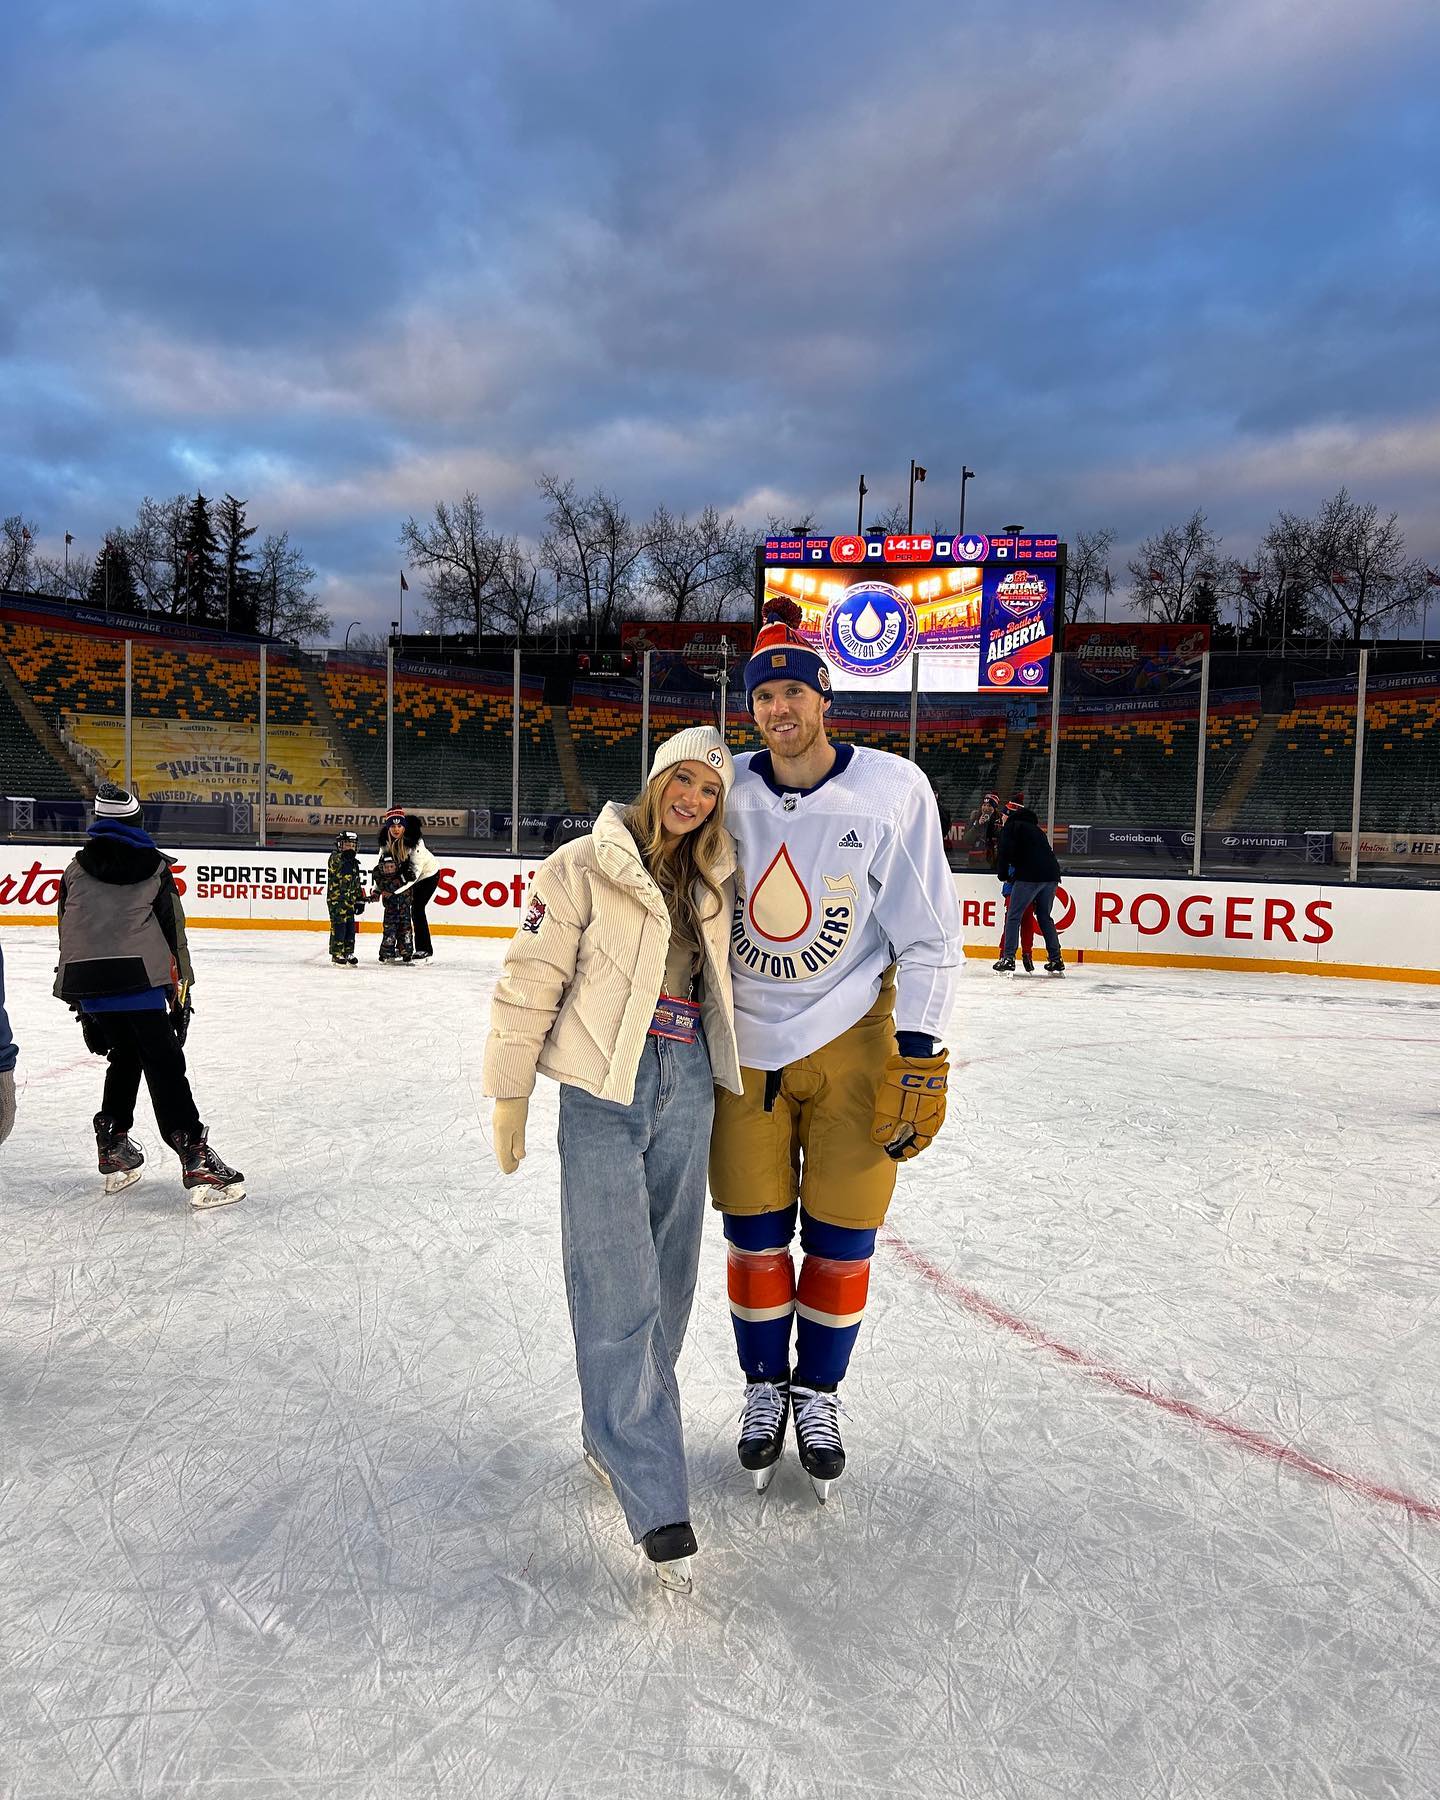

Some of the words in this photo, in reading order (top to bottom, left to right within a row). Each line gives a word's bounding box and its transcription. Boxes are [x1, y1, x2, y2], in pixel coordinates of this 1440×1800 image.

[888, 539, 931, 551] 14:16
[936, 542, 950, 556] 0
[991, 539, 1014, 547] SOG
[812, 550, 822, 560] 0
[868, 543, 882, 557] 0
[997, 547, 1008, 558] 0
[997, 582, 1046, 592] HERITAGE
[116, 618, 161, 633] HERITAGE
[162, 626, 200, 639] CLASSIC
[990, 629, 1005, 641] The
[1007, 615, 1031, 634] Battle
[1033, 611, 1041, 624] of
[840, 624, 875, 658] EDMONTON
[876, 623, 898, 651] OILERS
[986, 619, 1046, 663] ALBERTA
[682, 643, 739, 656] HERITAGE
[1077, 645, 1140, 659] HERITAGE
[407, 664, 449, 677] HERITAGE
[1388, 675, 1438, 687] HERITAGE
[1114, 701, 1160, 711] HERITAGE
[870, 710, 909, 718] HERITAGE
[710, 752, 721, 766] 97
[148, 791, 185, 802] TWISTED
[284, 794, 323, 807] DECK
[275, 813, 305, 824] Hortons
[575, 820, 594, 829] ROG
[838, 840, 863, 849] adidas
[1242, 838, 1288, 847] HYUNDAI
[1359, 841, 1389, 853] Hortons
[197, 866, 277, 884] SPORTS
[962, 900, 996, 927] RE
[1094, 891, 1334, 944] ROGERS
[731, 894, 797, 979] EDMONTON
[800, 906, 850, 973] OILERS
[901, 1074, 947, 1089] CC
